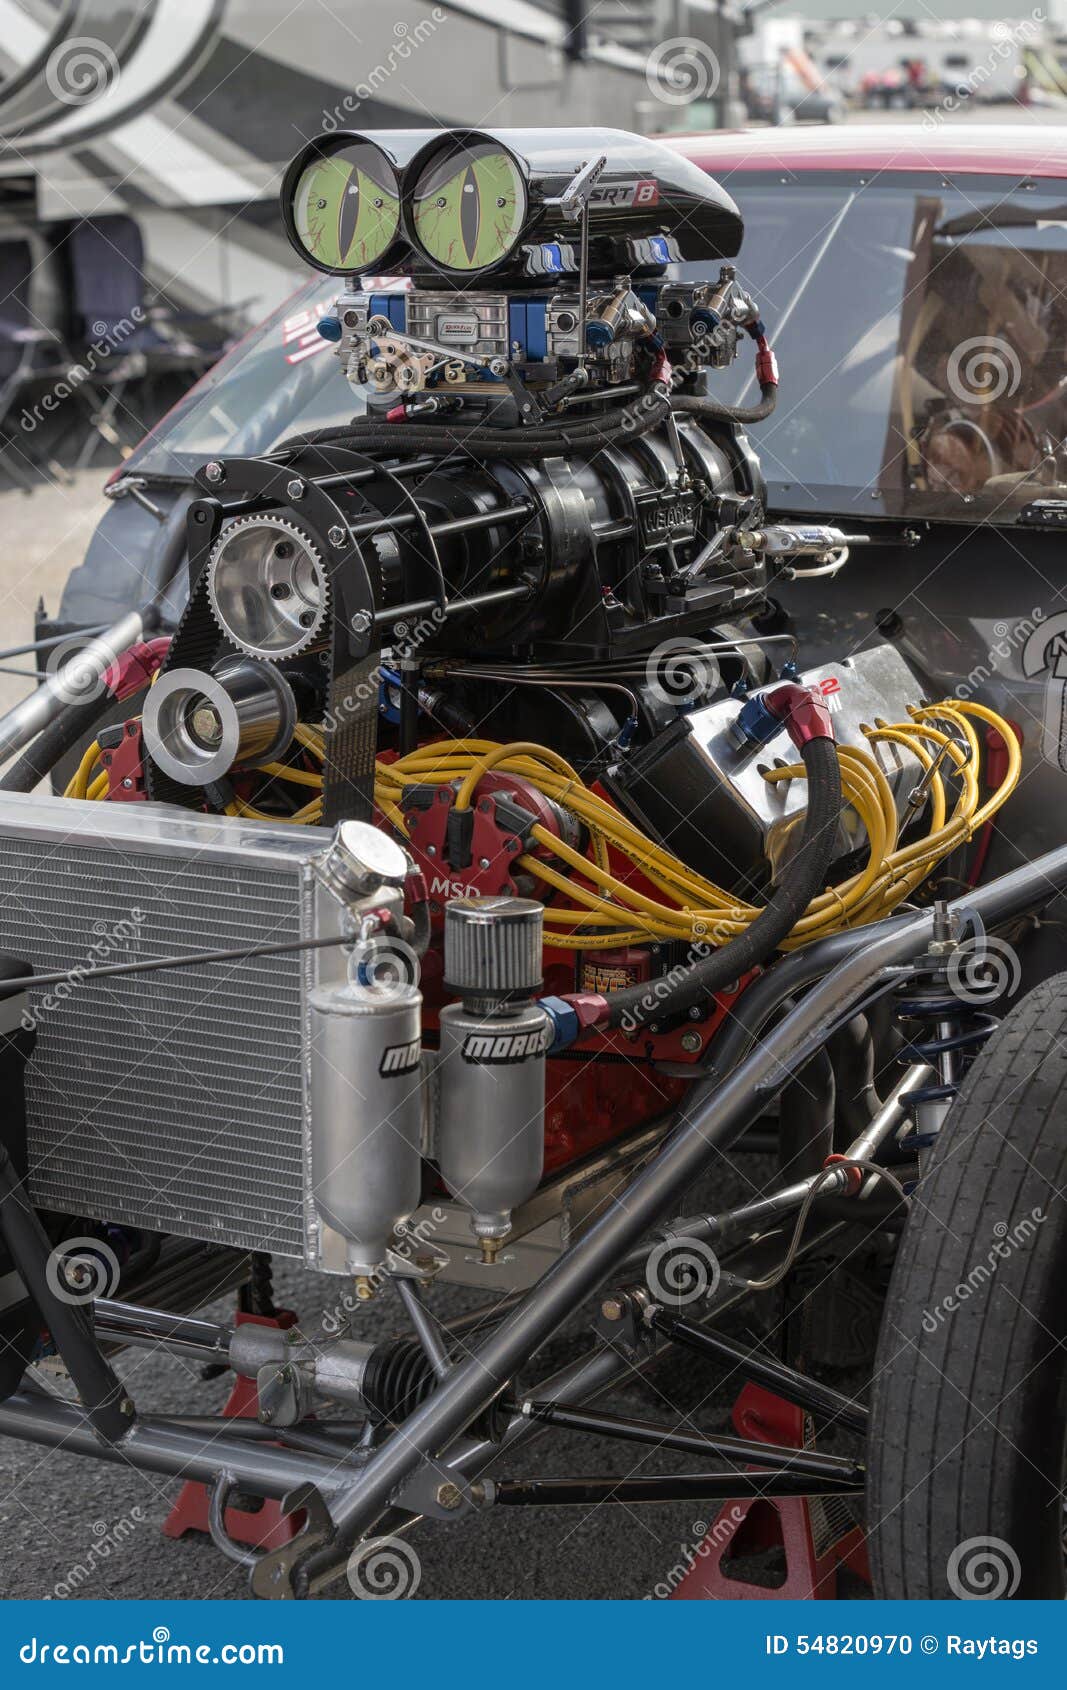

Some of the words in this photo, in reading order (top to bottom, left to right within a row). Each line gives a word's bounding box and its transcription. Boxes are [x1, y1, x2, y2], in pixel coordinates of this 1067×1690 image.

[589, 187, 634, 205] SRT
[638, 186, 654, 201] 8
[430, 877, 480, 900] MSD
